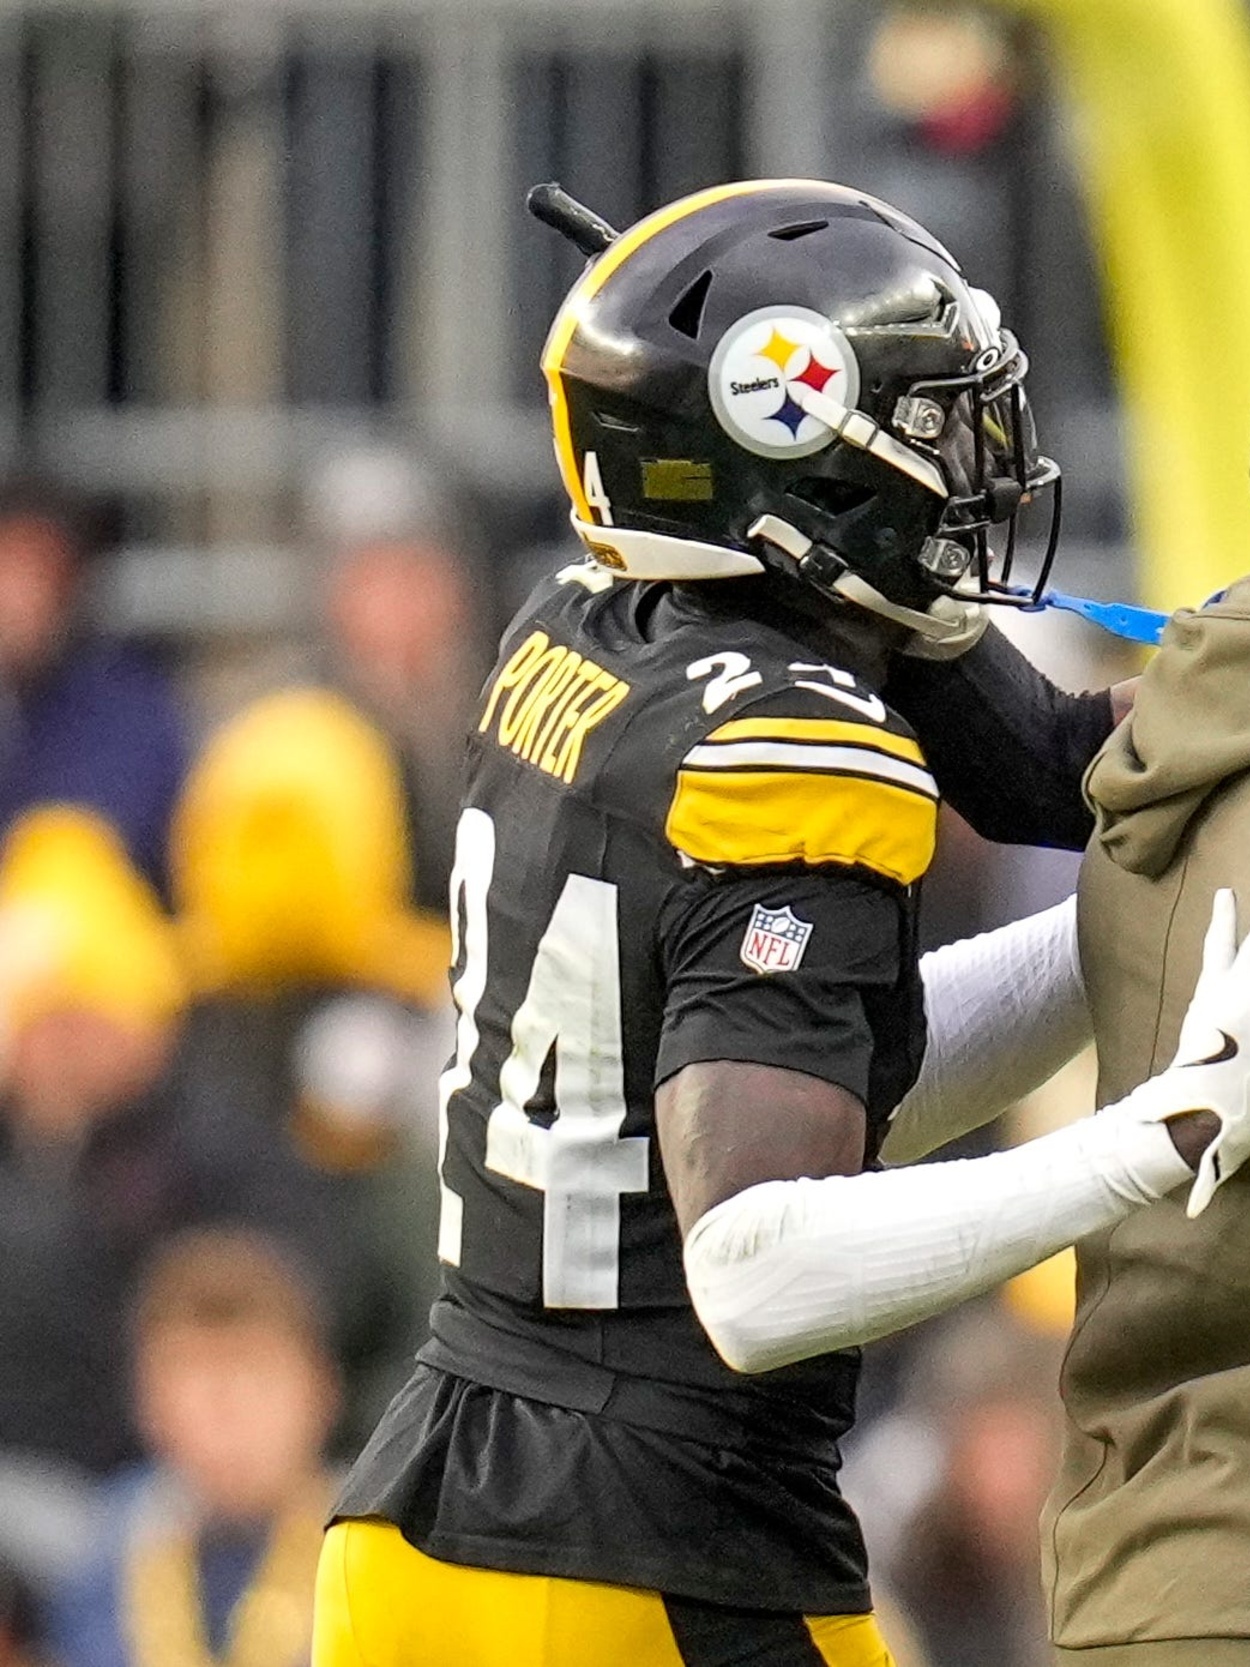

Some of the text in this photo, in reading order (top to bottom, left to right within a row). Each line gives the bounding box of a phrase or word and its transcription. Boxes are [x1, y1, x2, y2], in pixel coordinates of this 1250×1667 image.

[730, 377, 779, 396] Steelers
[583, 451, 614, 526] 4
[477, 629, 631, 785] PORTER
[748, 932, 790, 966] NFL
